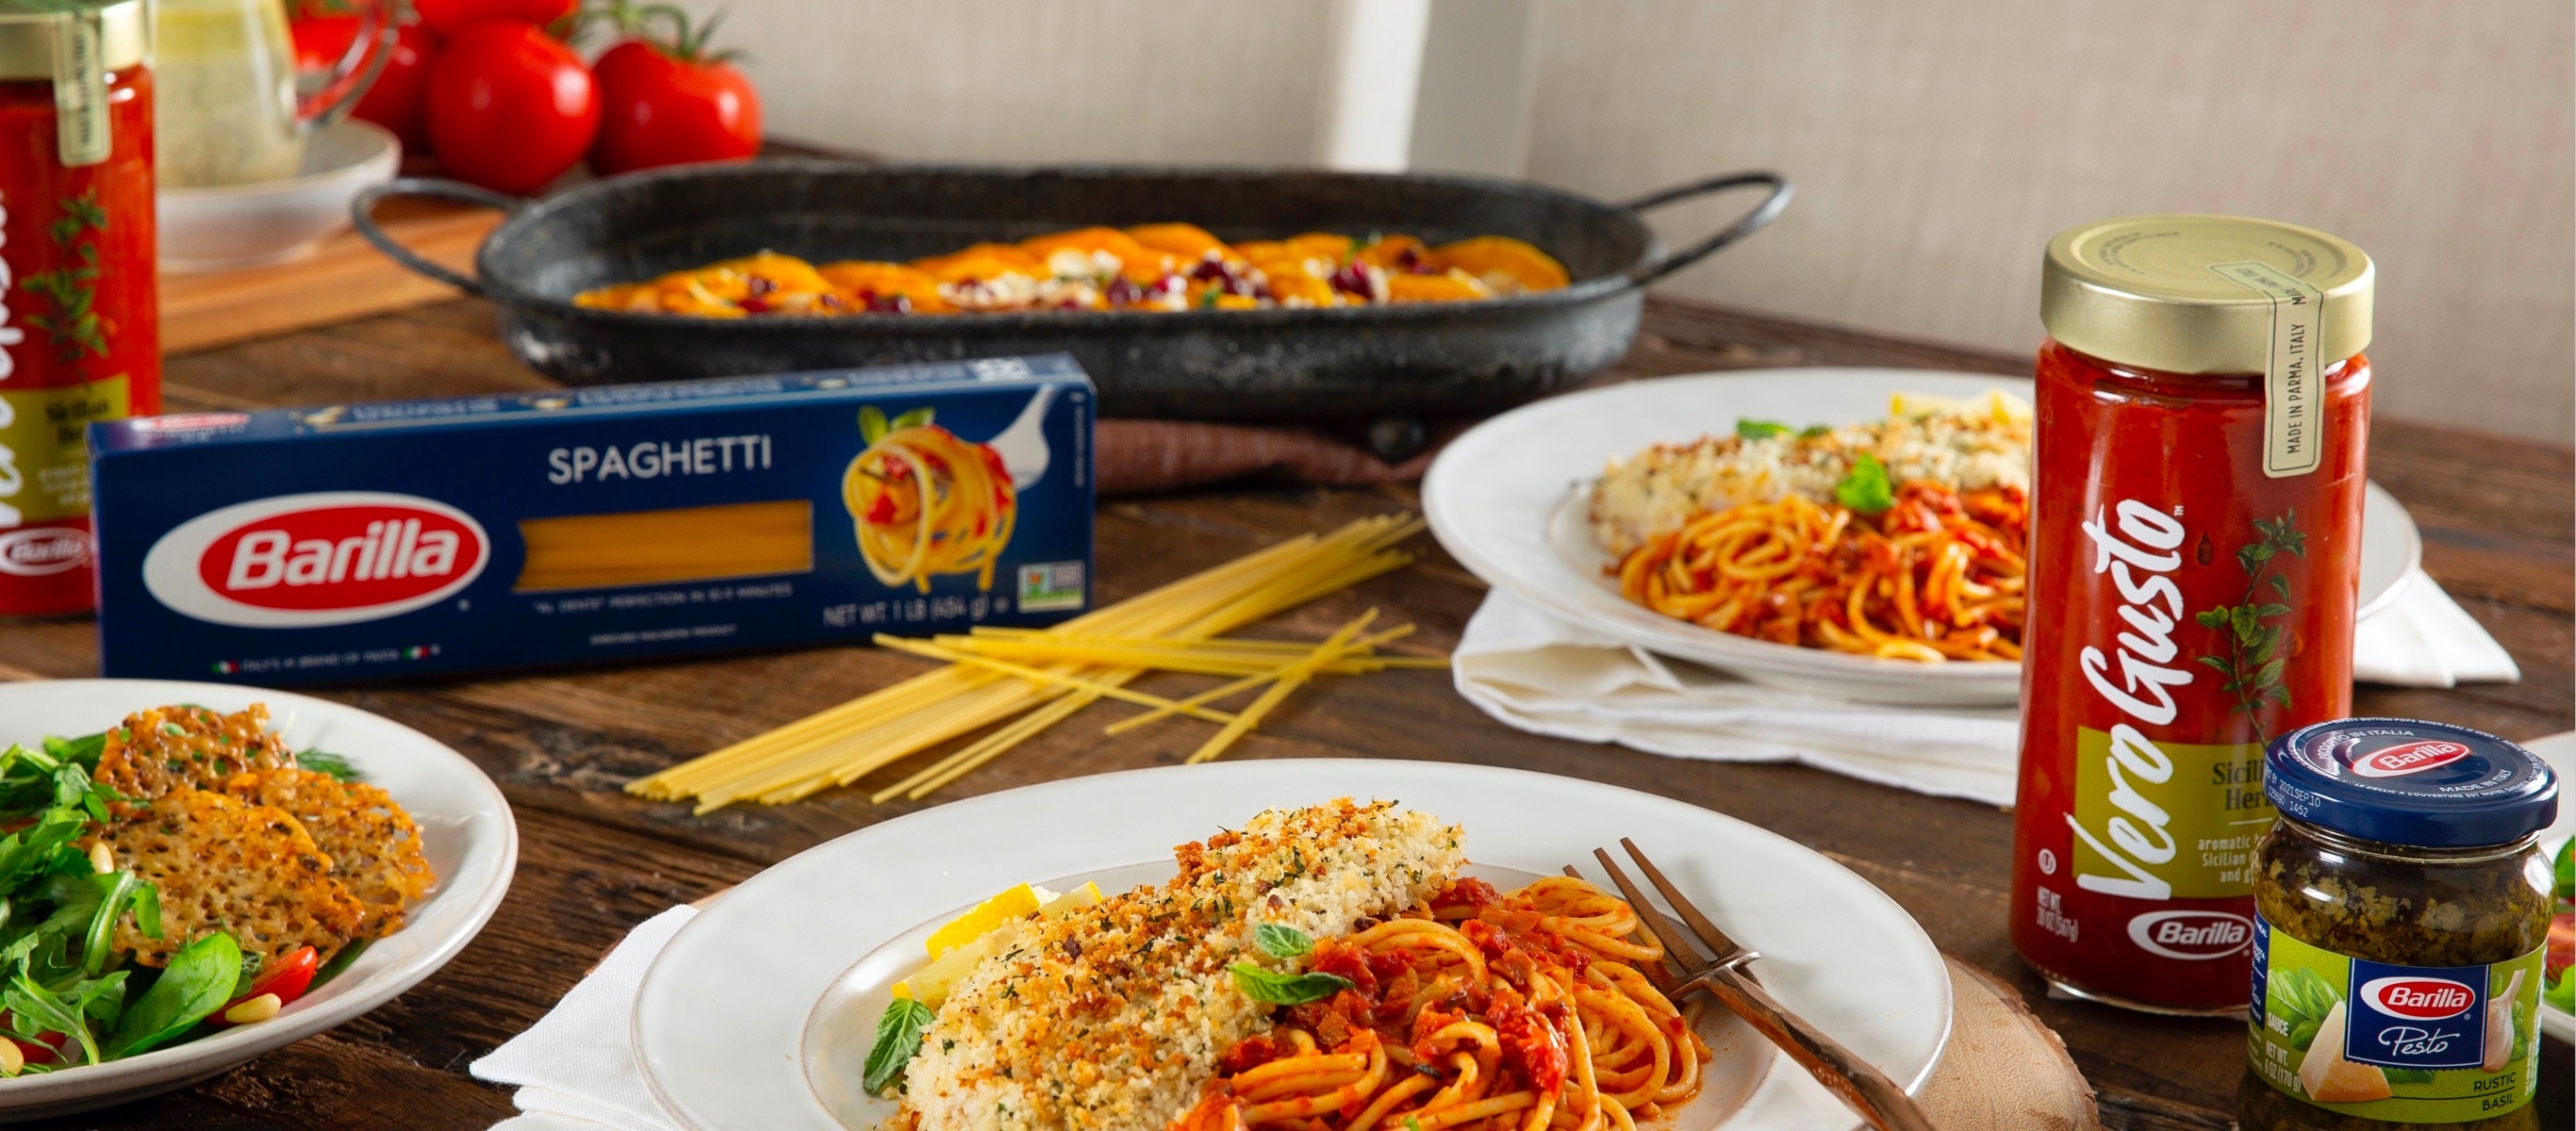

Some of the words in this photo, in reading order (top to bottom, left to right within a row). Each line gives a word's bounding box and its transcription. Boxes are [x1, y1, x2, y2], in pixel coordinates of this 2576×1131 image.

[2289, 322, 2305, 355] ITALY
[2287, 356, 2304, 401] PARMA,
[2288, 404, 2304, 420] IN
[2287, 420, 2304, 454] MADE
[548, 434, 772, 485] SPAGHETTI
[9, 537, 84, 561] Barilla
[225, 517, 461, 591] Barilla
[823, 603, 858, 628] NET
[905, 598, 927, 622] LB
[2446, 722, 2465, 730] SEAL
[2378, 743, 2459, 770] Barilla
[2213, 759, 2263, 785] Sicili
[2439, 782, 2484, 794] MADE
[2481, 779, 2494, 788] IN
[2492, 768, 2513, 784] ITALY
[2407, 790, 2464, 799] L'OUVERTURE
[2197, 835, 2252, 851] aromatic
[2202, 852, 2247, 867] Sicilian
[2220, 867, 2242, 883] and
[2156, 921, 2246, 945] Barilla
[2387, 987, 2468, 1008] Barilla
[2267, 1011, 2289, 1037] SAUCE
[2266, 1040, 2277, 1058] NET
[2277, 1045, 2288, 1067] WT.
[2378, 1026, 2461, 1056] Pesto
[2265, 1057, 2270, 1074] 6
[2270, 1063, 2277, 1080] OZ
[2277, 1066, 2293, 1088] (170
[2292, 1074, 2302, 1093] g)
[2473, 1072, 2518, 1092] RUSTIC
[2483, 1092, 2516, 1111] BASIL
